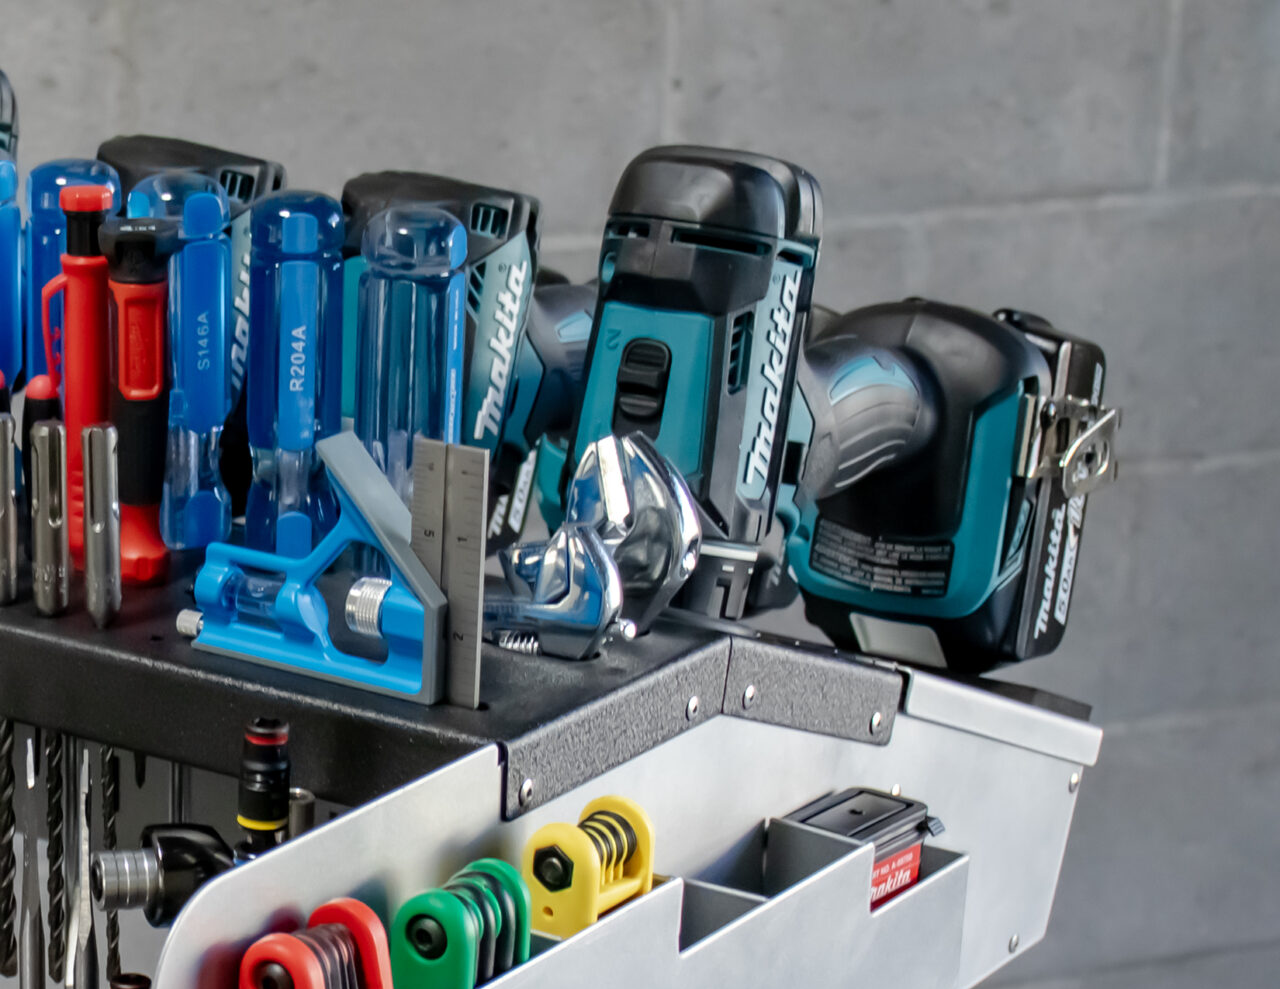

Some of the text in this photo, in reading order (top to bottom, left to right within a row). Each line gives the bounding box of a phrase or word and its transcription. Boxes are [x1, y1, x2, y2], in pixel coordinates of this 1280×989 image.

[197, 311, 210, 371] S146A
[289, 325, 307, 392] R204A
[474, 261, 527, 440] makita
[745, 271, 801, 484] makita
[1034, 503, 1066, 639] makita
